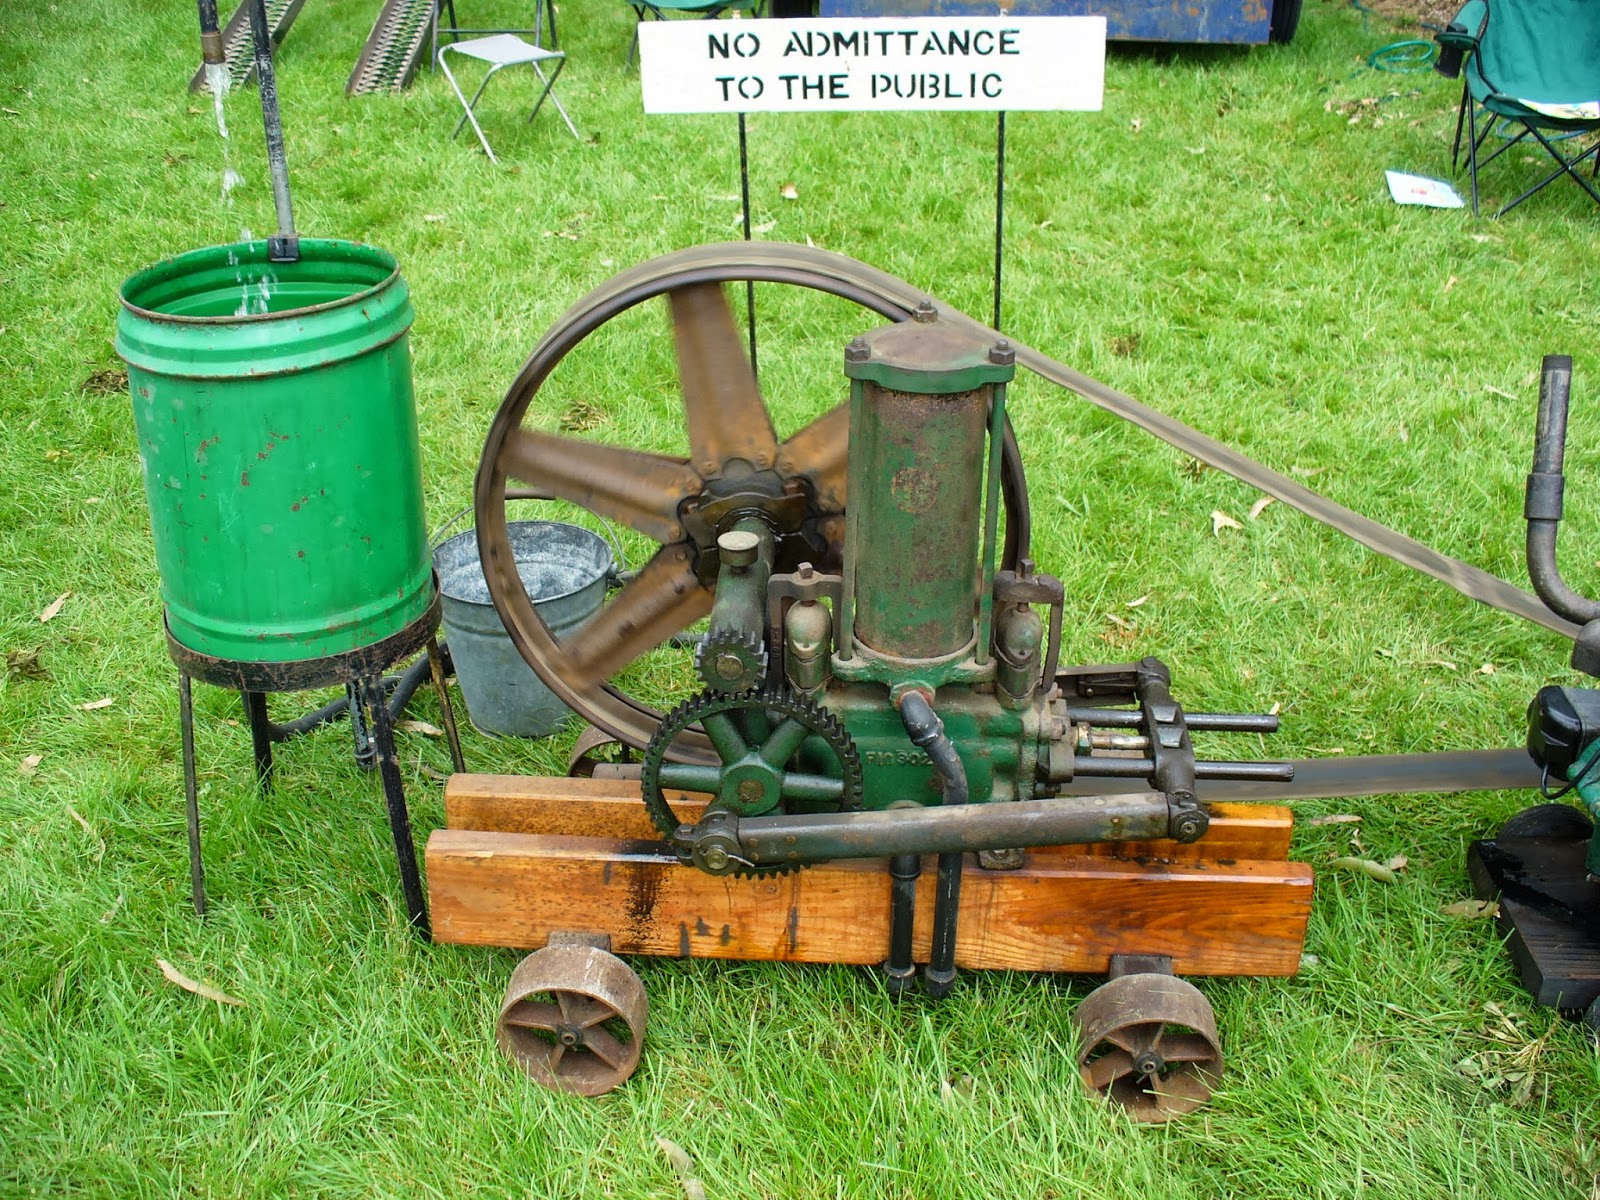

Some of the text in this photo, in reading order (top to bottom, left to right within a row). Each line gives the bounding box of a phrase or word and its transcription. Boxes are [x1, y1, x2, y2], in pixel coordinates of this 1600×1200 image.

[708, 30, 1020, 58] NO ADMITTANCE
[715, 73, 1002, 101] TO THE PUBLIC
